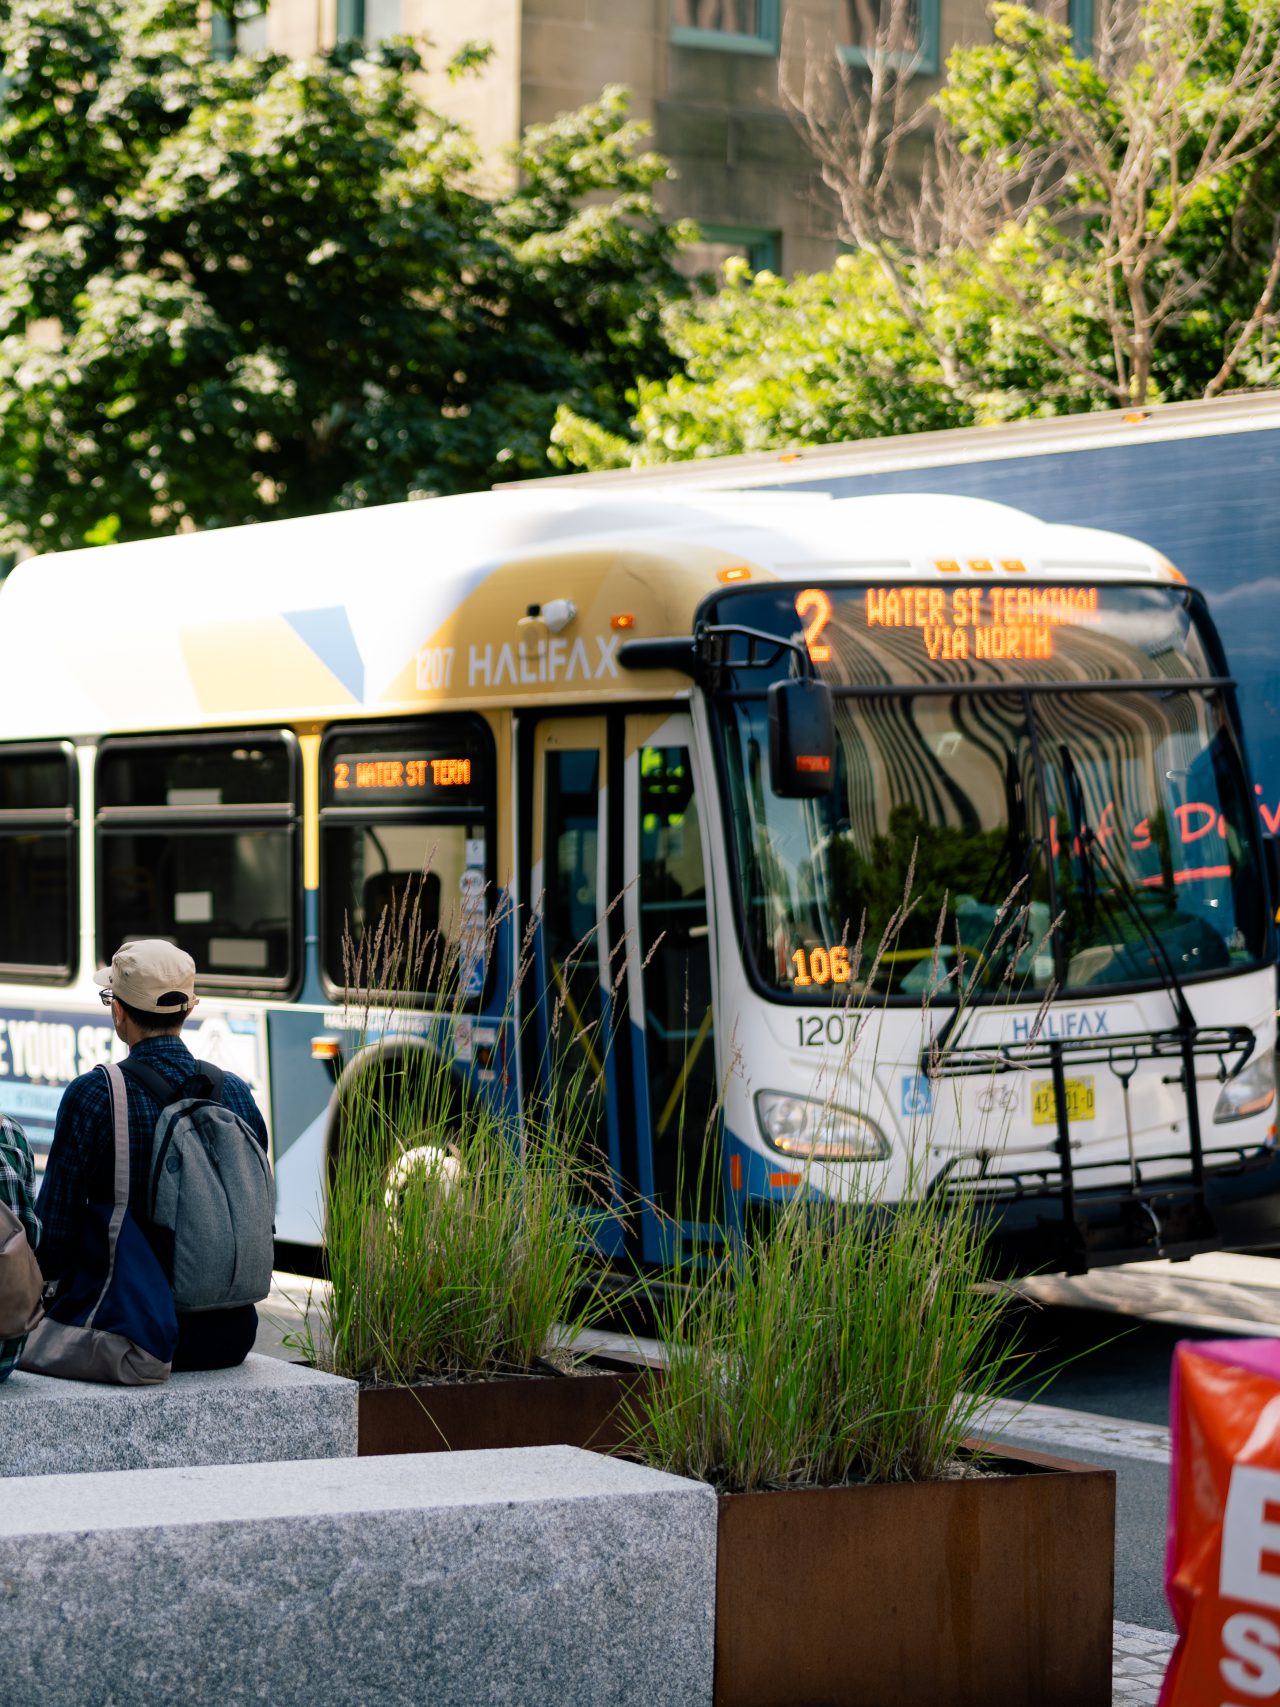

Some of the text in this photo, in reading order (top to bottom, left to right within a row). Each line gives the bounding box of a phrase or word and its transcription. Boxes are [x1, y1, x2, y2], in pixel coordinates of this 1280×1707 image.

[795, 588, 833, 662] 2
[865, 587, 1101, 627] WATER ST TERMINAL
[416, 634, 621, 690] 1207 HALIFAX
[923, 625, 1053, 660] VIA NORTH
[334, 759, 471, 789] 2 WATER ST TERM
[791, 945, 851, 986] 106
[796, 1013, 863, 1047] 1207
[8, 1019, 78, 1082] YOUR
